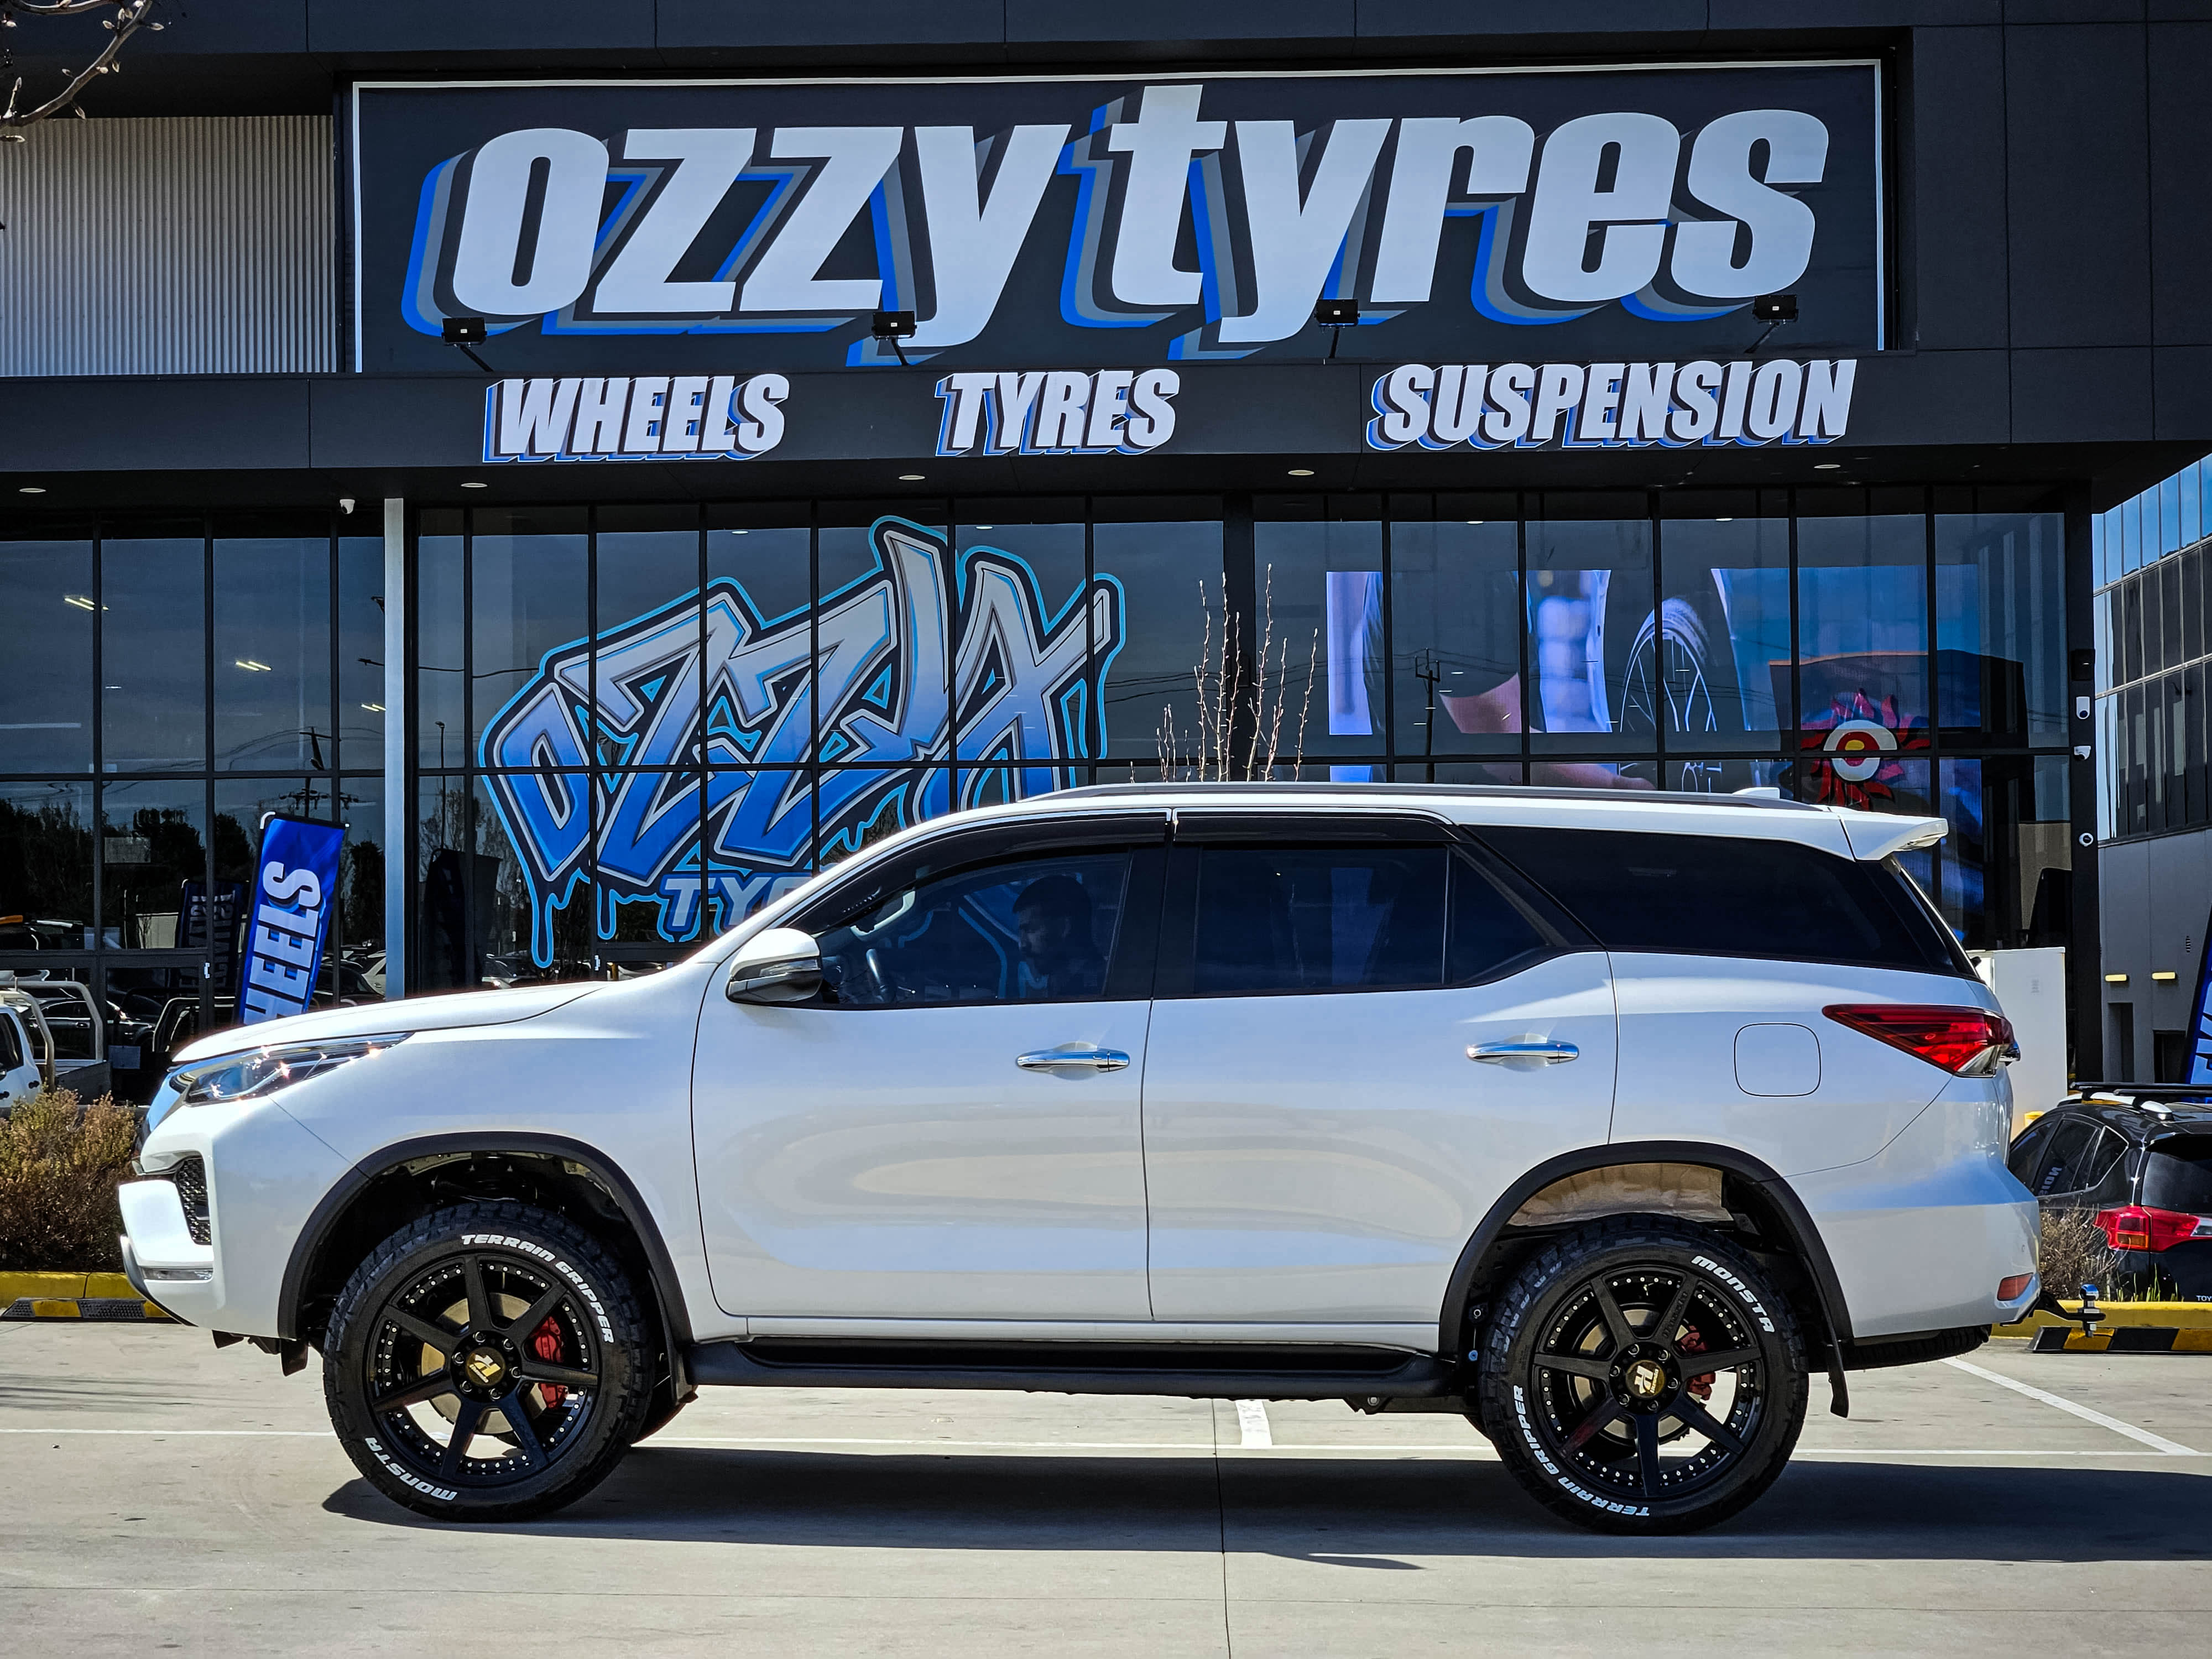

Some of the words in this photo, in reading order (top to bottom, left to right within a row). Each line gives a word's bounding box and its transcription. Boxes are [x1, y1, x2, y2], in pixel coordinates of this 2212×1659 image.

[483, 373, 790, 462] WHEELS
[937, 367, 1181, 456] TYRES
[1368, 359, 1858, 450] SUSPENSION
[461, 1234, 555, 1262] TERRAIN
[555, 1260, 614, 1344] GRIPPER
[1691, 1255, 1775, 1333] MONSTA
[364, 1437, 458, 1502] MONSTA
[1512, 1384, 1560, 1475] GRIPPER
[1558, 1475, 1650, 1517] TERRAIN
